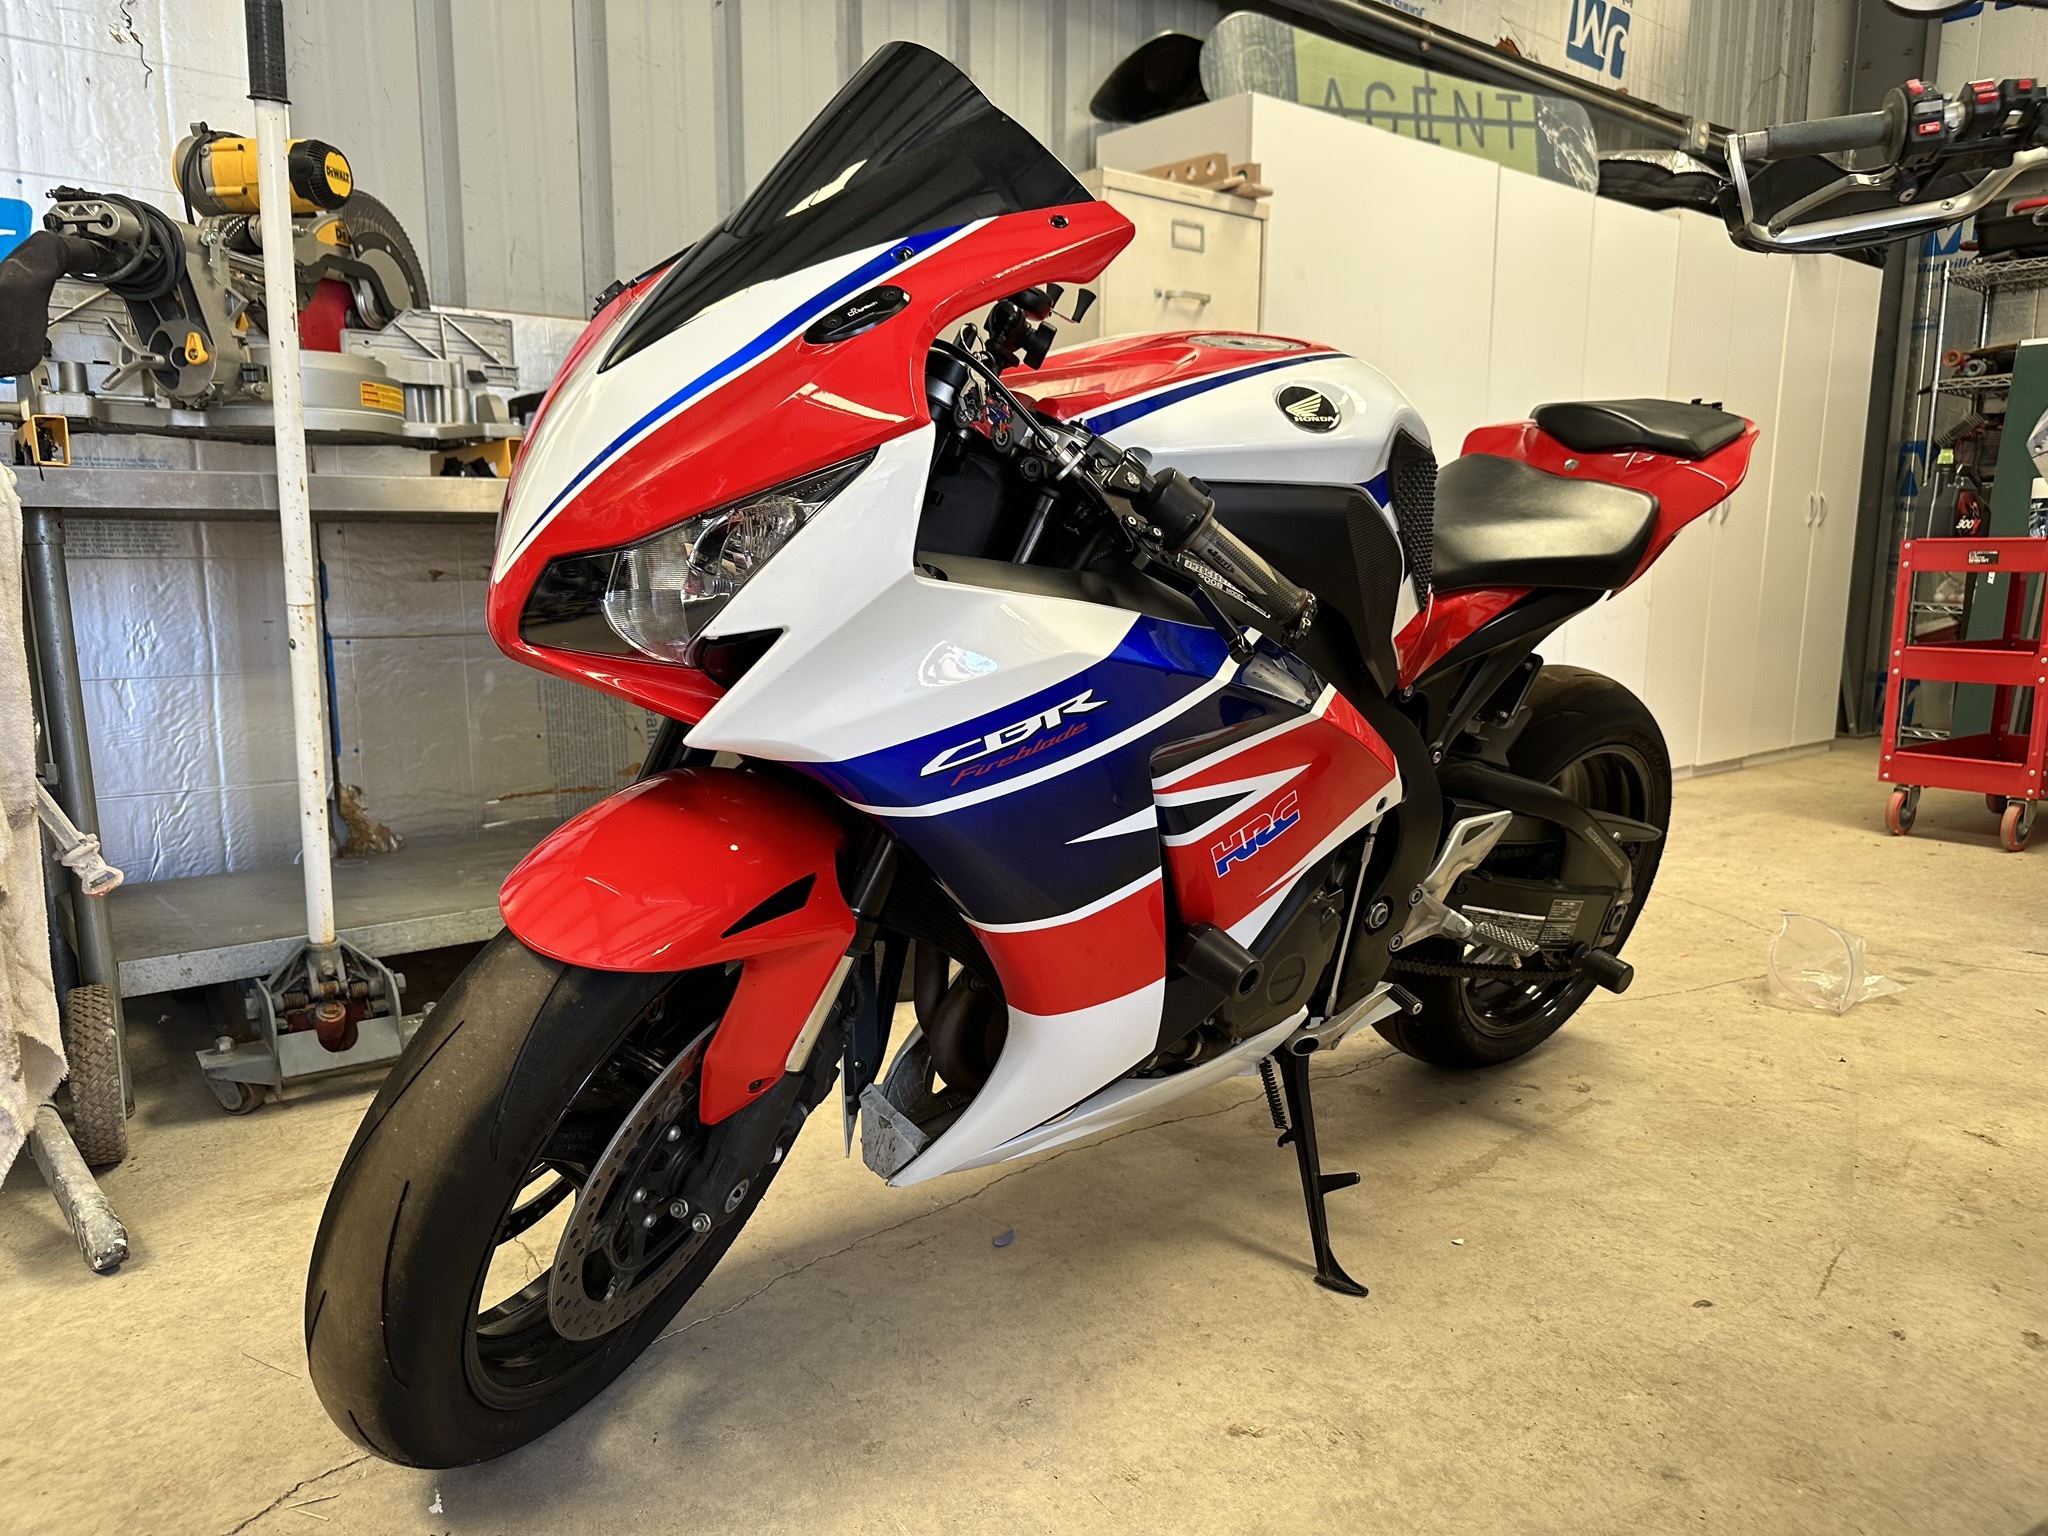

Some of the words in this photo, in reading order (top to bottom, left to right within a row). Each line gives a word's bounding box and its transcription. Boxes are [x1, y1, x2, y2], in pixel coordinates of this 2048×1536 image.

[920, 689, 1109, 777] CBR
[951, 721, 1088, 786] Fireblade
[1210, 790, 1300, 879] HRC
